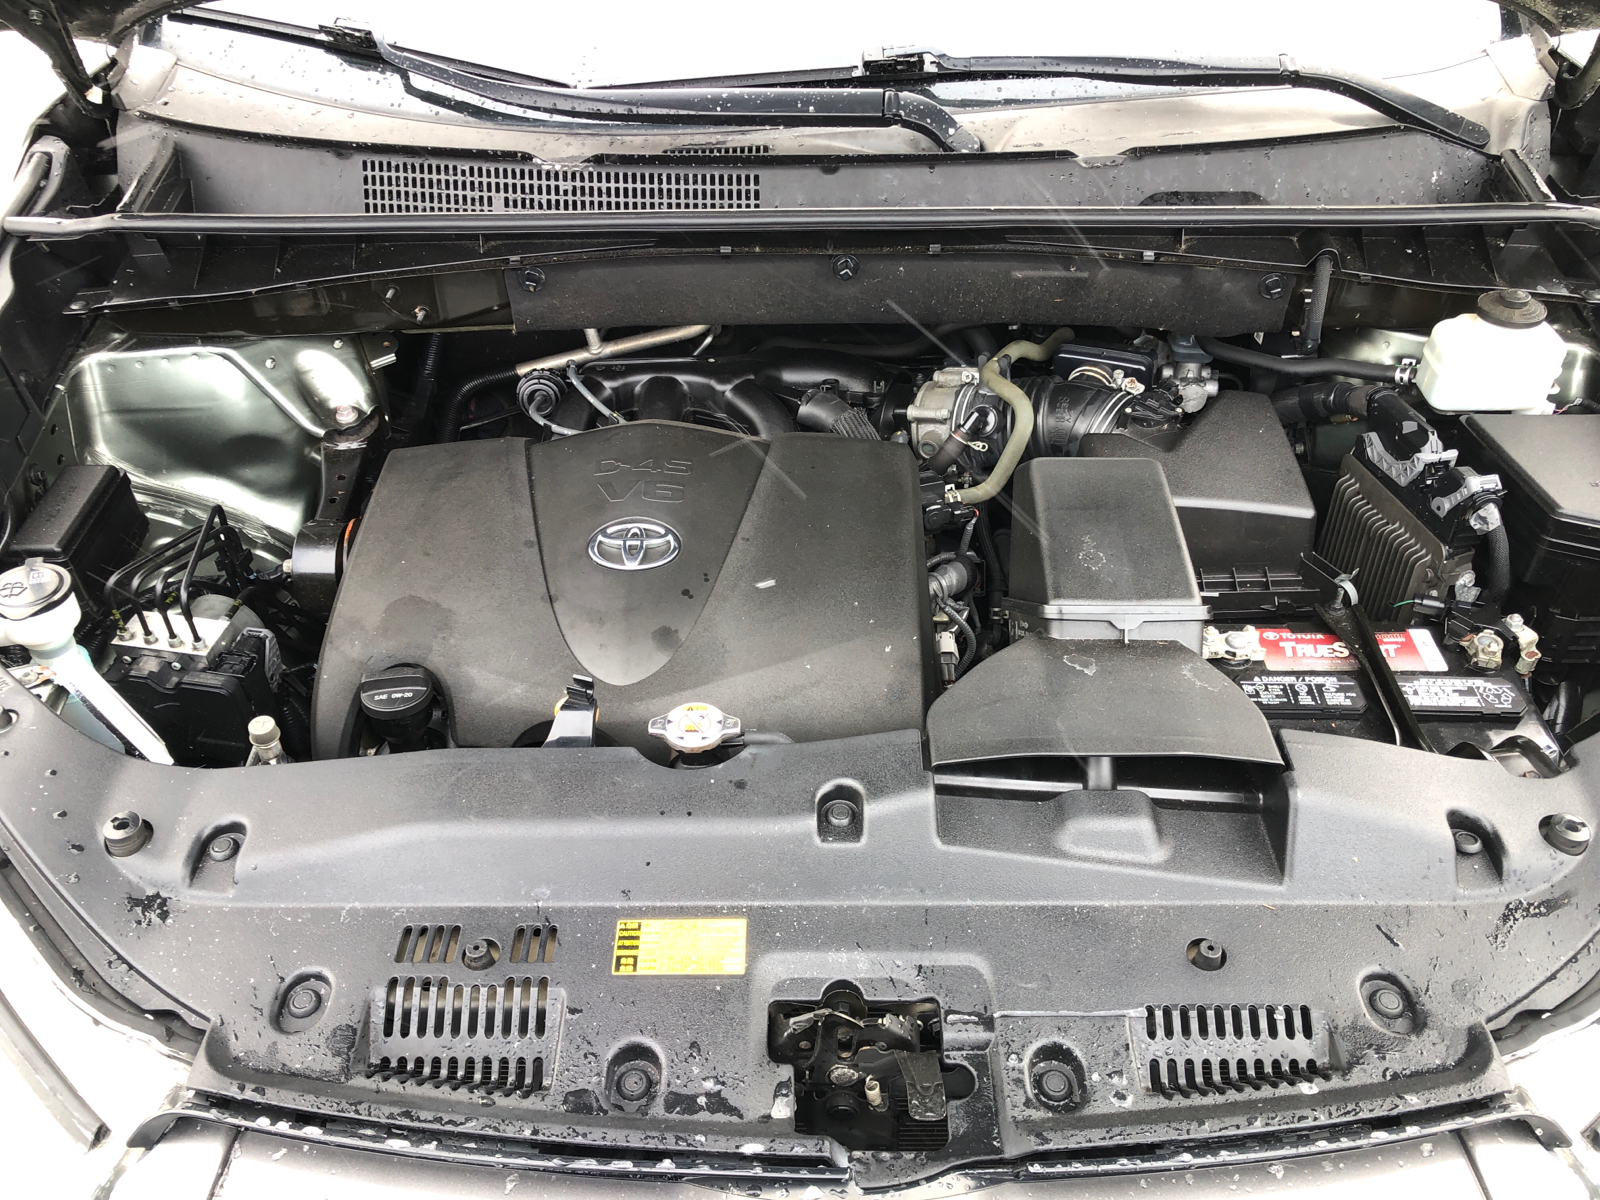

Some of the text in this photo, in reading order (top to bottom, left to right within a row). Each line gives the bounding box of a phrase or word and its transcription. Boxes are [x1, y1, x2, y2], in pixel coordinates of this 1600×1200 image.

[594, 458, 692, 476] D-4S
[597, 480, 685, 502] V6
[1279, 632, 1325, 640] TOYOTA
[1279, 641, 1397, 658] TRUESRT
